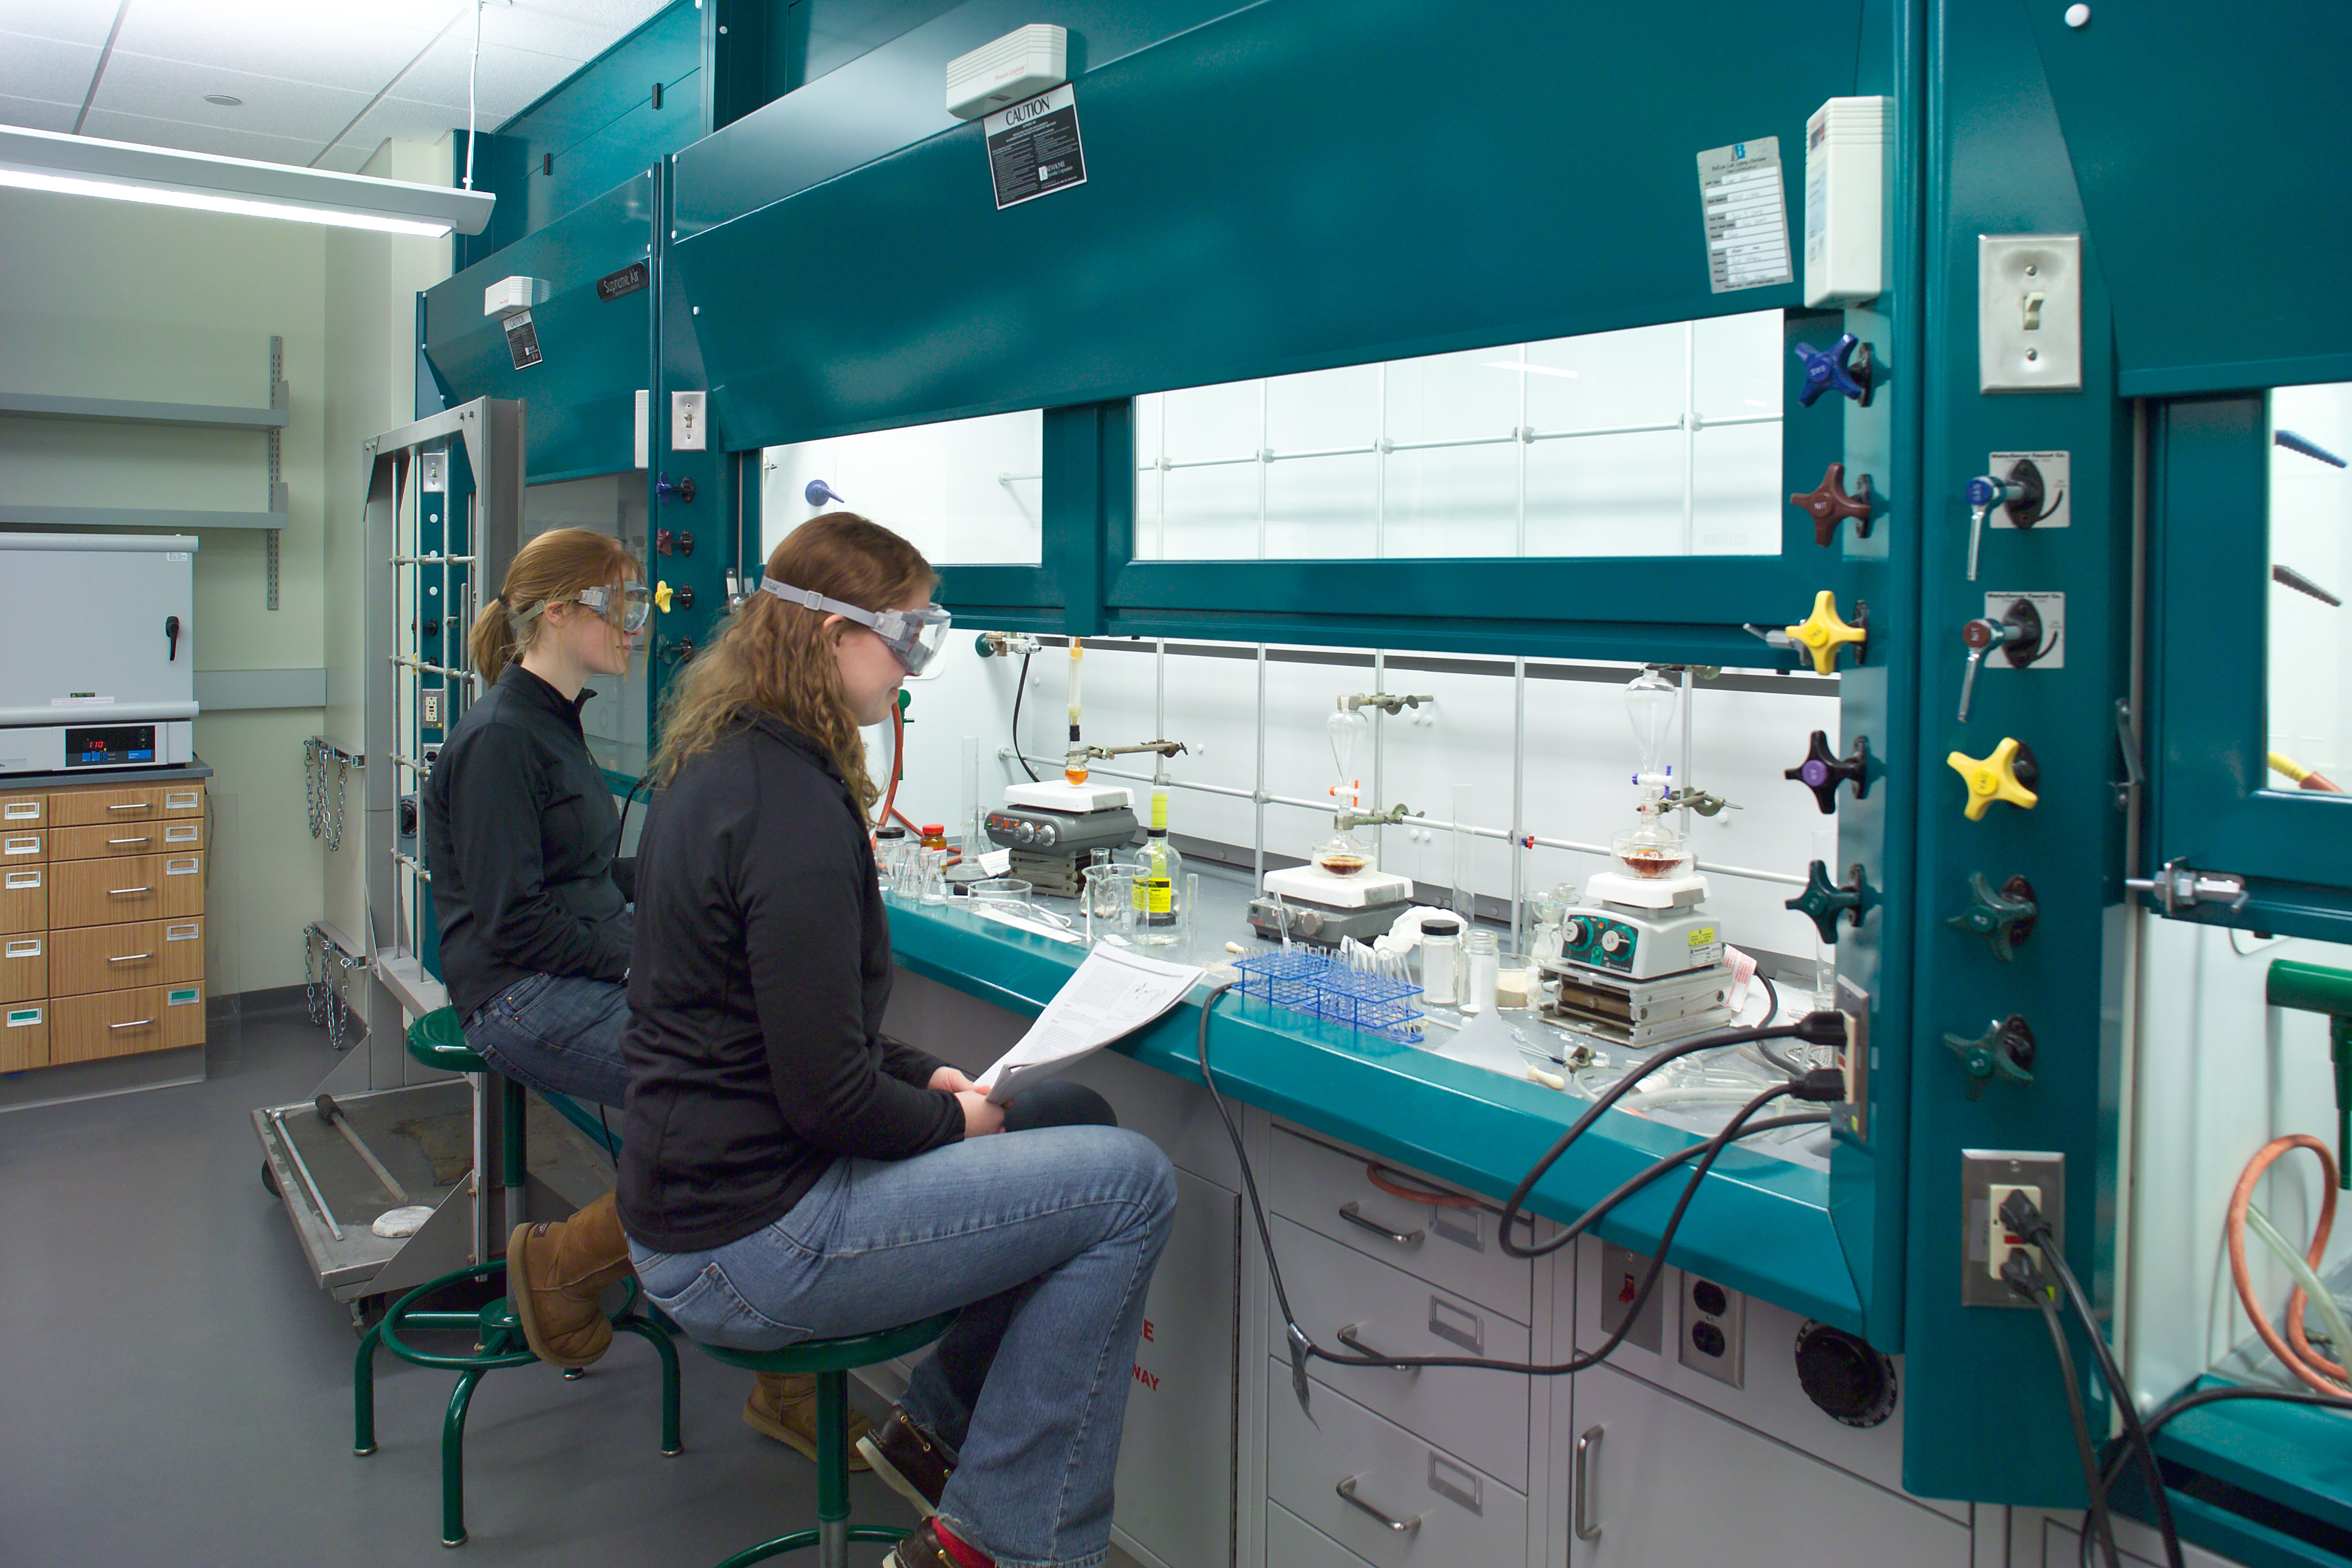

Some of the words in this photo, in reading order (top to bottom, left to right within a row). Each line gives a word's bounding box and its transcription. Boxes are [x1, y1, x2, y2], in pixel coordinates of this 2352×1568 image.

[1006, 96, 1051, 126] CAUTION
[603, 275, 630, 293] Supreme
[629, 268, 639, 283] Air
